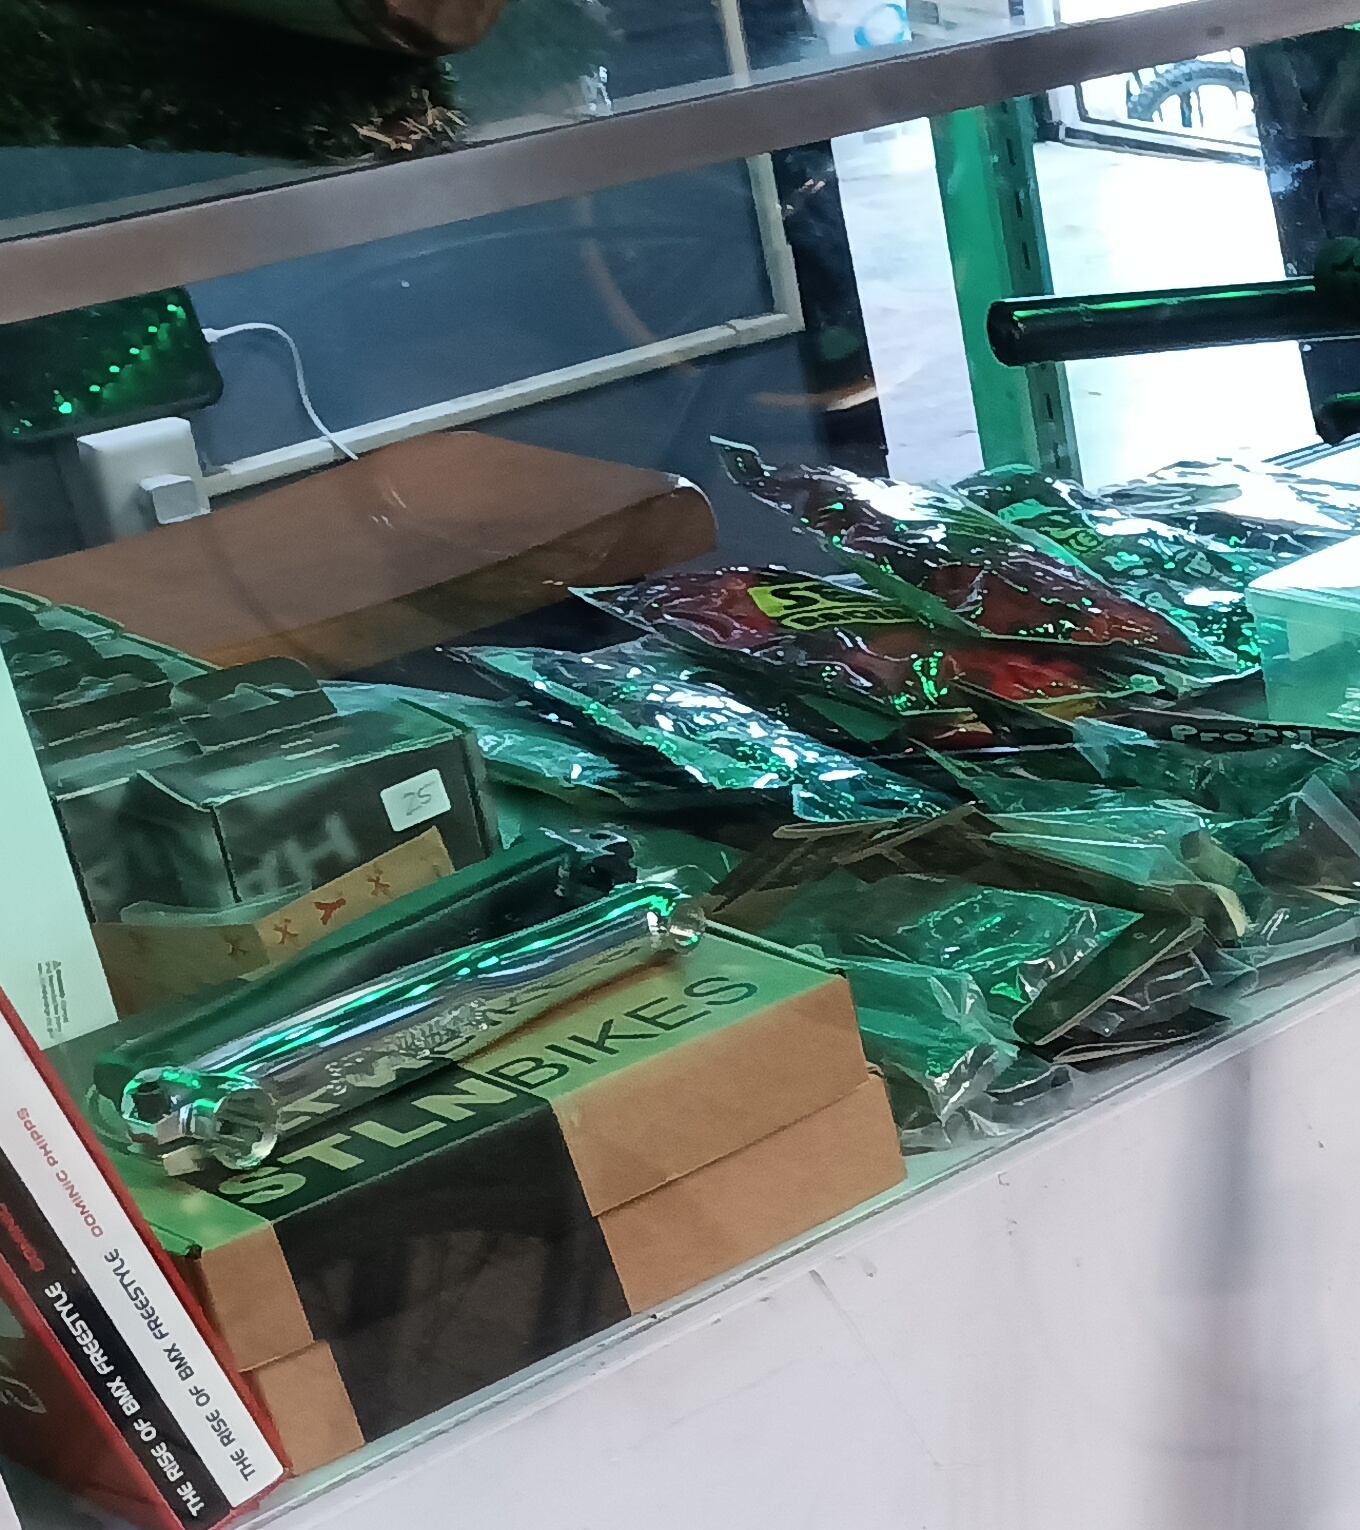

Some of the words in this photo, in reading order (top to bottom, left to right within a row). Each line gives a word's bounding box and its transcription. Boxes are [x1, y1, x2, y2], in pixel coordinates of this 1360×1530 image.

[16, 1106, 59, 1168] PHIPPS
[55, 1168, 104, 1239] DOMINIC
[103, 1247, 170, 1342] FREESTYLE
[44, 1280, 115, 1376] FREESTYLE
[163, 1343, 196, 1383] BMX
[106, 1374, 141, 1417] BMX
[188, 1385, 211, 1407] OF
[133, 1417, 158, 1442] OF
[205, 1409, 237, 1448] RISE
[150, 1440, 185, 1482] RISE
[230, 1445, 256, 1482] THE
[176, 1479, 206, 1518] THE
